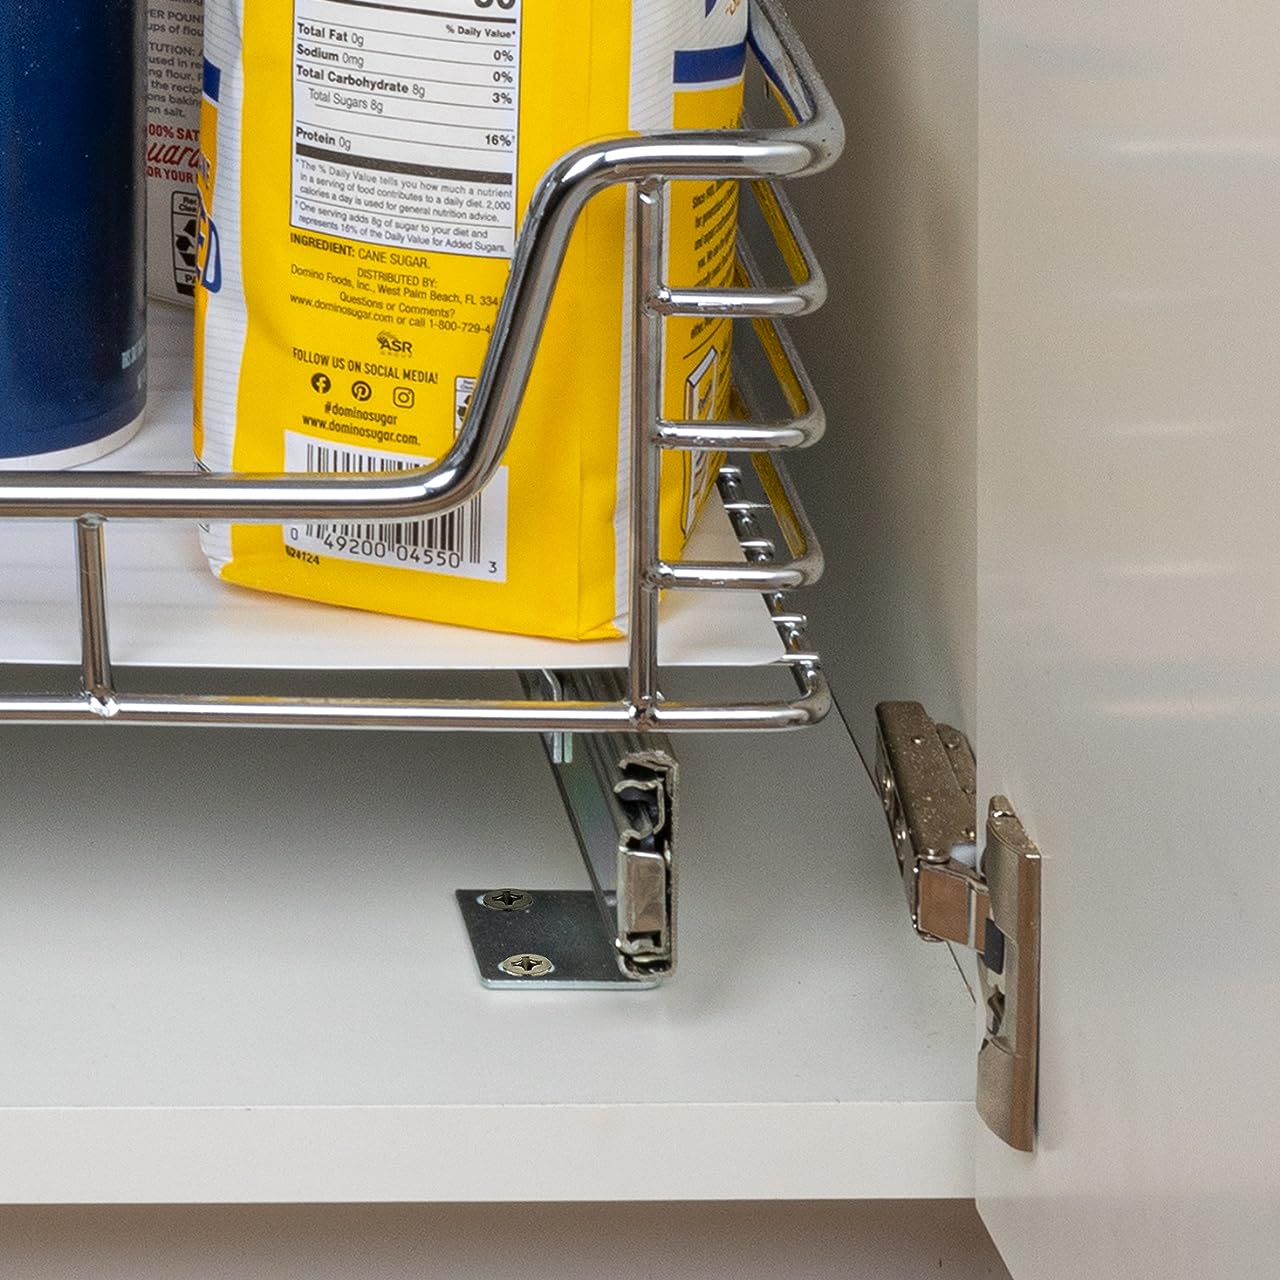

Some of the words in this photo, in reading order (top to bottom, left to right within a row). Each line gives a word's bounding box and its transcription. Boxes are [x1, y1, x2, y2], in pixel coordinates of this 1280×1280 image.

[169, 25, 180, 34] of
[297, 23, 325, 37] Total
[329, 30, 347, 41] Fat
[351, 33, 364, 46] 0g
[493, 50, 513, 62] 0%
[446, 25, 455, 33] %
[458, 26, 482, 38] Daily
[297, 44, 339, 61] Sodium
[342, 53, 364, 68] 0mg
[493, 71, 513, 83] 0%
[296, 65, 324, 80] Total
[328, 71, 408, 94] Carbohydrate
[412, 84, 425, 98] 8g
[492, 93, 512, 104] 3%
[308, 88, 330, 103] Total
[333, 93, 367, 109] Sugars
[370, 99, 383, 113] 8g
[149, 123, 174, 138] 00%
[296, 127, 335, 146] Protein
[339, 137, 351, 150] 0g
[301, 160, 315, 170] The
[329, 167, 350, 179] Daily
[353, 172, 377, 183] Value
[380, 177, 398, 186] tells
[401, 181, 417, 189] you
[420, 182, 438, 191] how
[441, 185, 466, 194] much
[477, 188, 512, 198] nutrient
[316, 178, 345, 191] serving
[358, 185, 375, 195] food
[377, 188, 423, 202] contributes
[444, 197, 463, 208] daily
[486, 201, 511, 210] 2,000
[300, 186, 330, 198] calories
[339, 196, 352, 205] day
[364, 200, 384, 208] used
[386, 202, 397, 210] for
[399, 205, 431, 215] general
[433, 209, 467, 219] nutrition
[469, 212, 499, 222] advice.
[300, 202, 315, 212] One
[318, 208, 347, 221] serving
[350, 215, 369, 224] adds
[396, 222, 418, 232] sugar
[421, 224, 429, 232] to
[432, 226, 451, 235] your
[453, 228, 469, 237] diet
[290, 232, 355, 257] INGREDIENT:
[358, 248, 386, 263] CANE
[390, 253, 430, 269] SUGAR.
[299, 216, 338, 229] represents
[341, 224, 357, 233] 16%
[370, 230, 382, 238] the
[385, 231, 405, 243] Daily
[407, 235, 430, 245] Value
[432, 238, 443, 246] for
[445, 239, 472, 250] Added
[475, 241, 506, 253] Sugars.
[291, 264, 324, 280] Domino
[327, 273, 354, 288] Foods,
[378, 284, 401, 296] West
[404, 288, 427, 299] Palm
[430, 291, 462, 304] Beach,
[465, 294, 476, 304] FL
[480, 296, 501, 306] 334
[357, 267, 419, 287] DISTRIBUTED
[422, 277, 437, 288] BY:
[290, 295, 393, 322] www.dominosugar.com
[396, 317, 405, 325] or
[409, 318, 425, 327] call
[430, 320, 492, 333] 1-800-729-4
[340, 292, 383, 309] Questions
[386, 303, 395, 311] or
[399, 302, 455, 318] Comments?
[381, 339, 413, 353] ASR
[293, 348, 329, 366] FOLLOW
[332, 358, 345, 370] US
[348, 360, 361, 371] ON
[365, 363, 399, 379] SOCIAL
[403, 370, 438, 384] MEDIA!
[325, 402, 397, 425] #dominosugar
[291, 527, 299, 541] 0
[324, 533, 386, 557] 49200
[397, 545, 460, 568] 04550
[489, 561, 497, 573] 3
